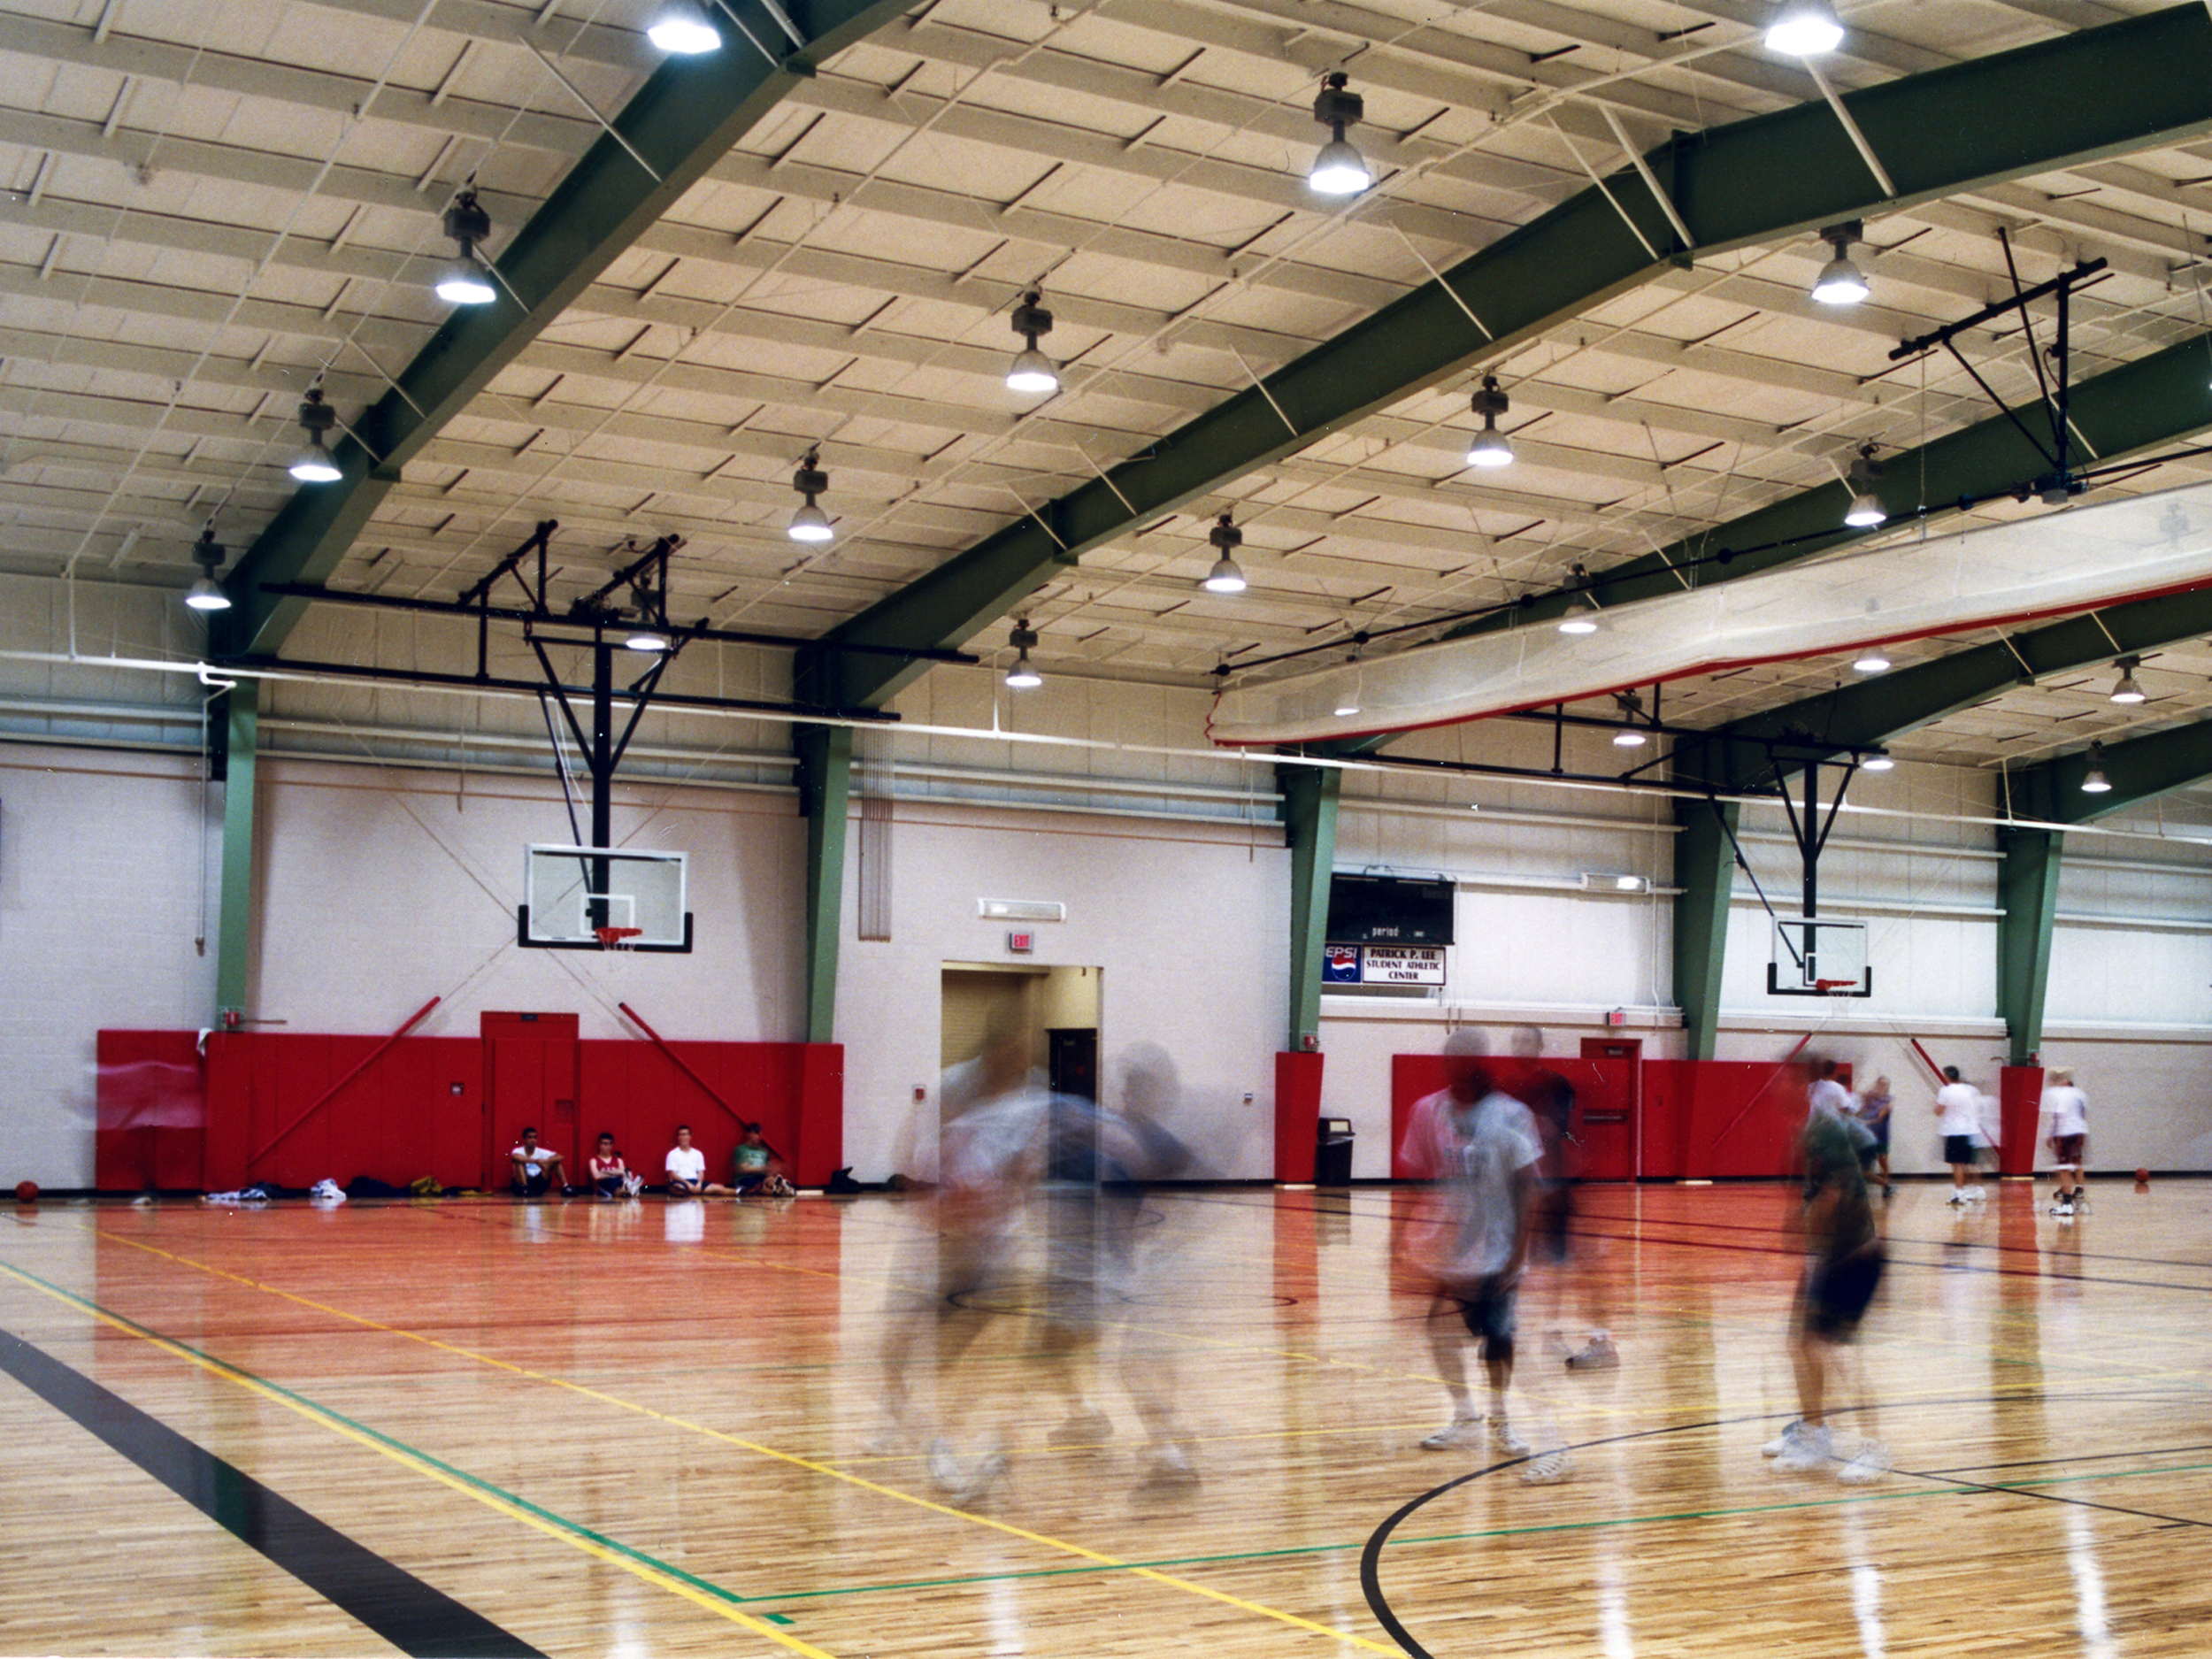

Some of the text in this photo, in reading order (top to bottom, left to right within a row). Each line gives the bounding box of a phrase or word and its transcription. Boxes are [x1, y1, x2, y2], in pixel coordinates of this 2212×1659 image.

[1371, 926, 1399, 937] period
[1325, 946, 1358, 959] EPSI
[1371, 948, 1436, 960] PATRICK P. LEE
[1366, 960, 1440, 971] STUDENT ATHLETIC
[1388, 971, 1418, 979] CENTER
